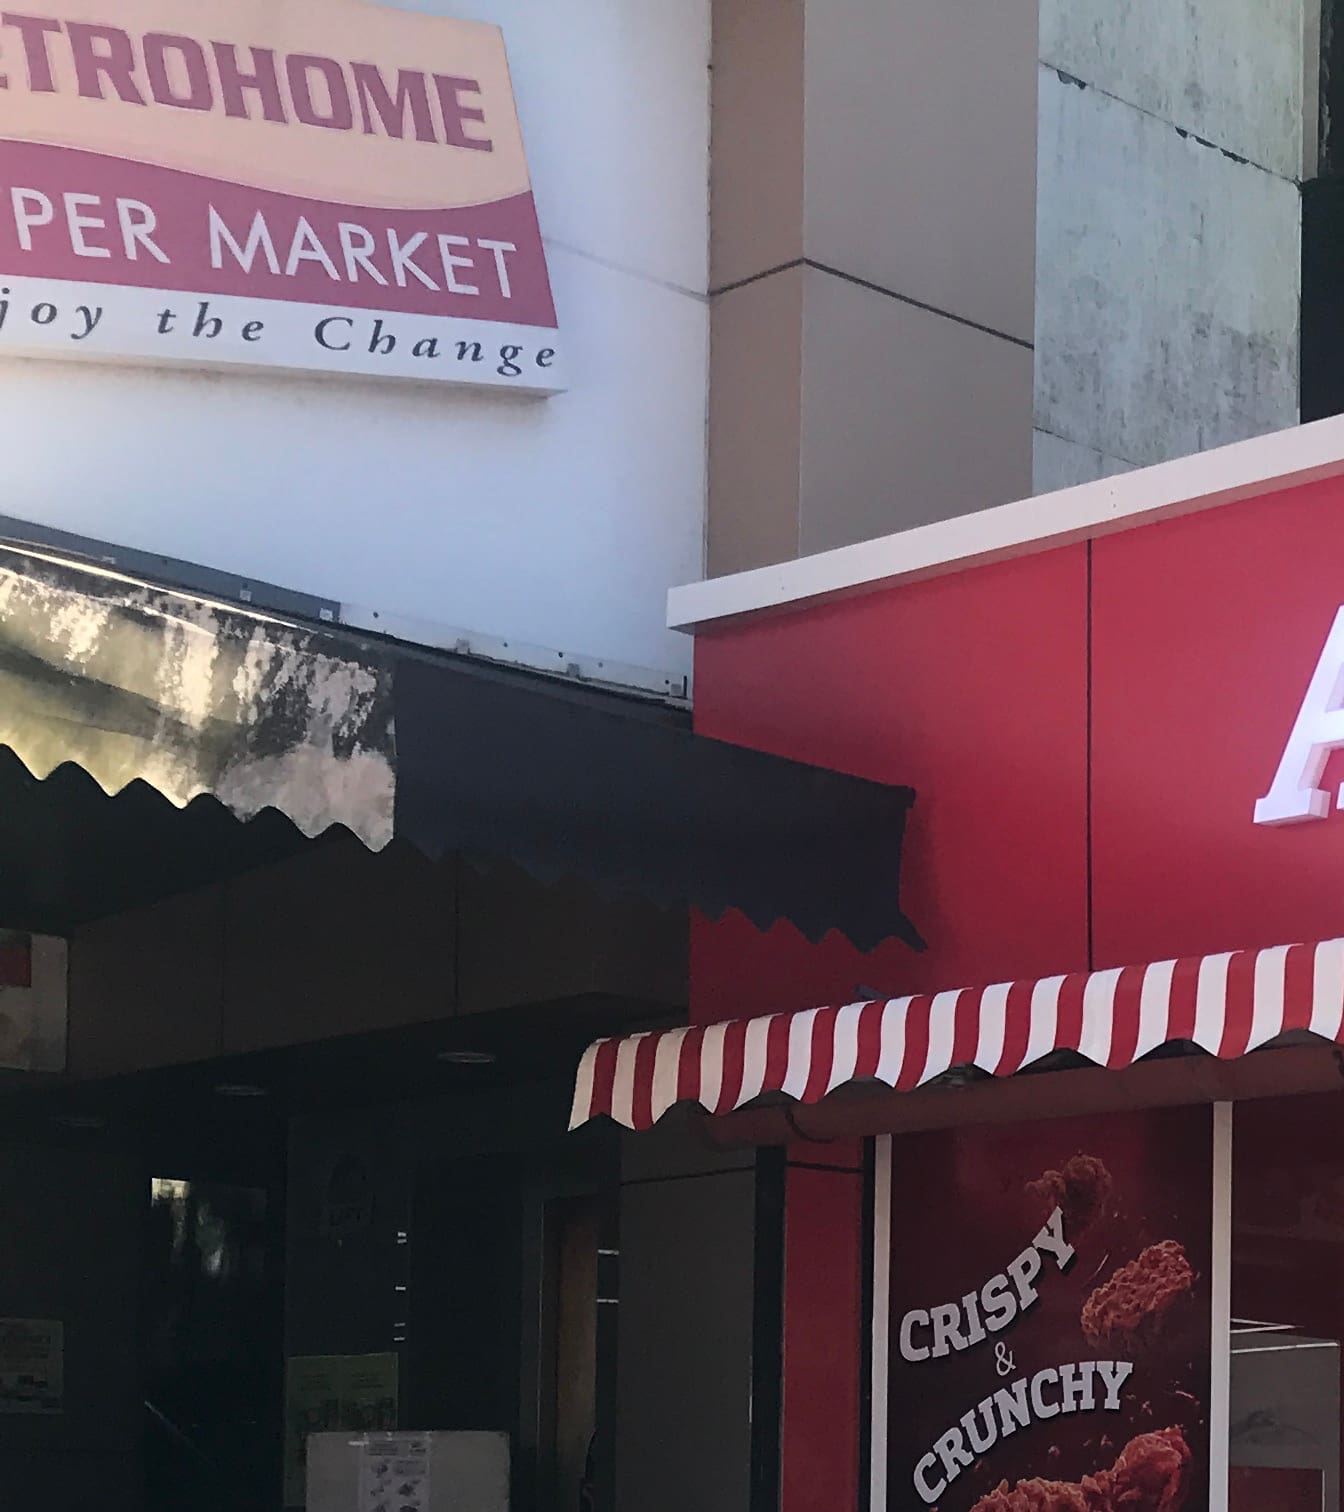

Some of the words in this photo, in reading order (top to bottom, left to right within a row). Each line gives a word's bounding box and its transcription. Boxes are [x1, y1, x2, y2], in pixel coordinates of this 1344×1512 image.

[0, 12, 493, 152] TROHOME
[209, 206, 517, 298] MARKET
[156, 303, 265, 341] the
[314, 315, 555, 376] Change
[900, 1207, 1075, 1362] CRISPY
[995, 1341, 1017, 1376] &
[913, 1360, 1134, 1504] CRUNCHY
